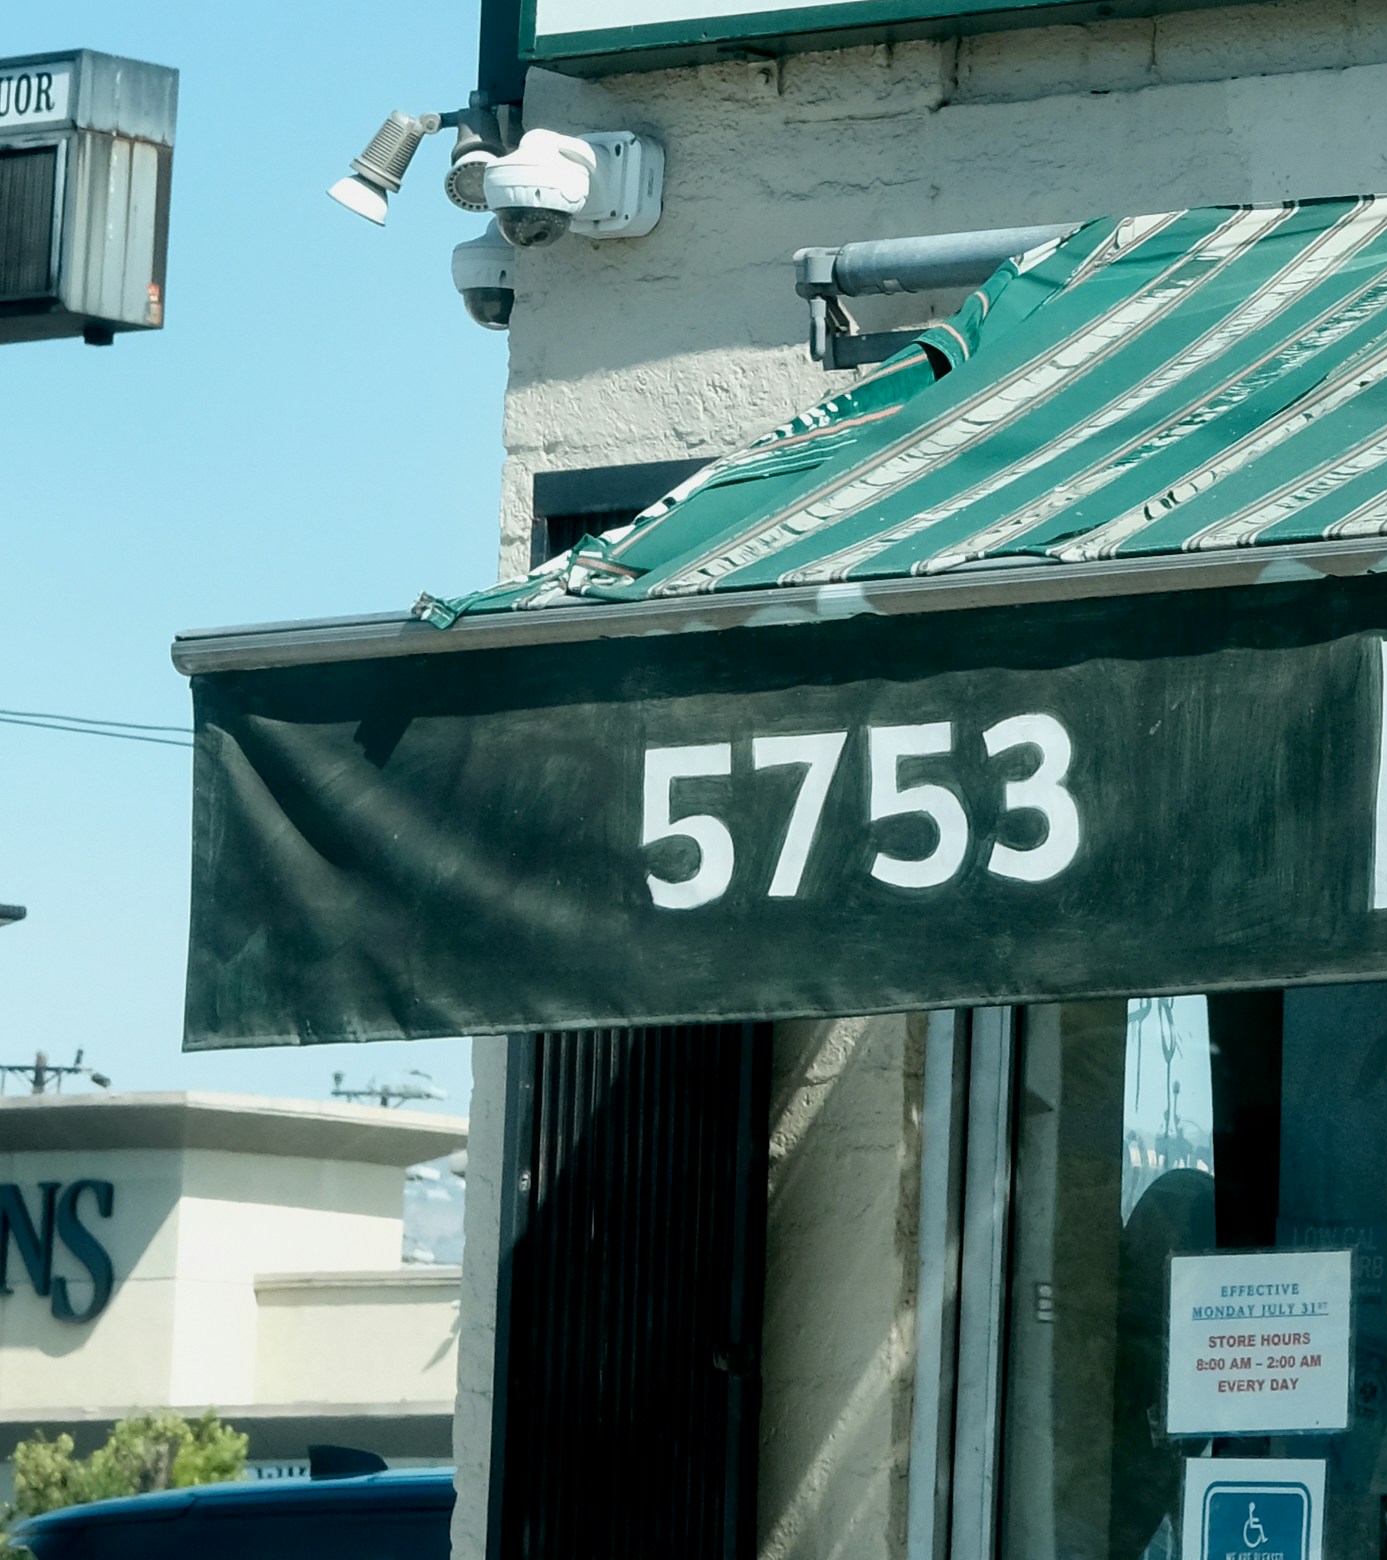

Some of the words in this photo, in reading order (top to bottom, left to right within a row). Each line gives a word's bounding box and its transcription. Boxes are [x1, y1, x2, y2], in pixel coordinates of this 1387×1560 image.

[637, 713, 1081, 911] 5753
[1221, 1283, 1299, 1297] EFFECTIVE
[1192, 1303, 1255, 1319] MONDAY
[1261, 1304, 1296, 1318] JULY
[1208, 1334, 1256, 1348] STORE
[1260, 1332, 1311, 1347] HOURS
[1196, 1356, 1226, 1371] 8:00
[1229, 1357, 1251, 1370] AM
[1266, 1355, 1296, 1369] 2:00
[1300, 1354, 1322, 1368] AM
[1218, 1379, 1265, 1393] EVERY
[1270, 1377, 1299, 1391] DAY
